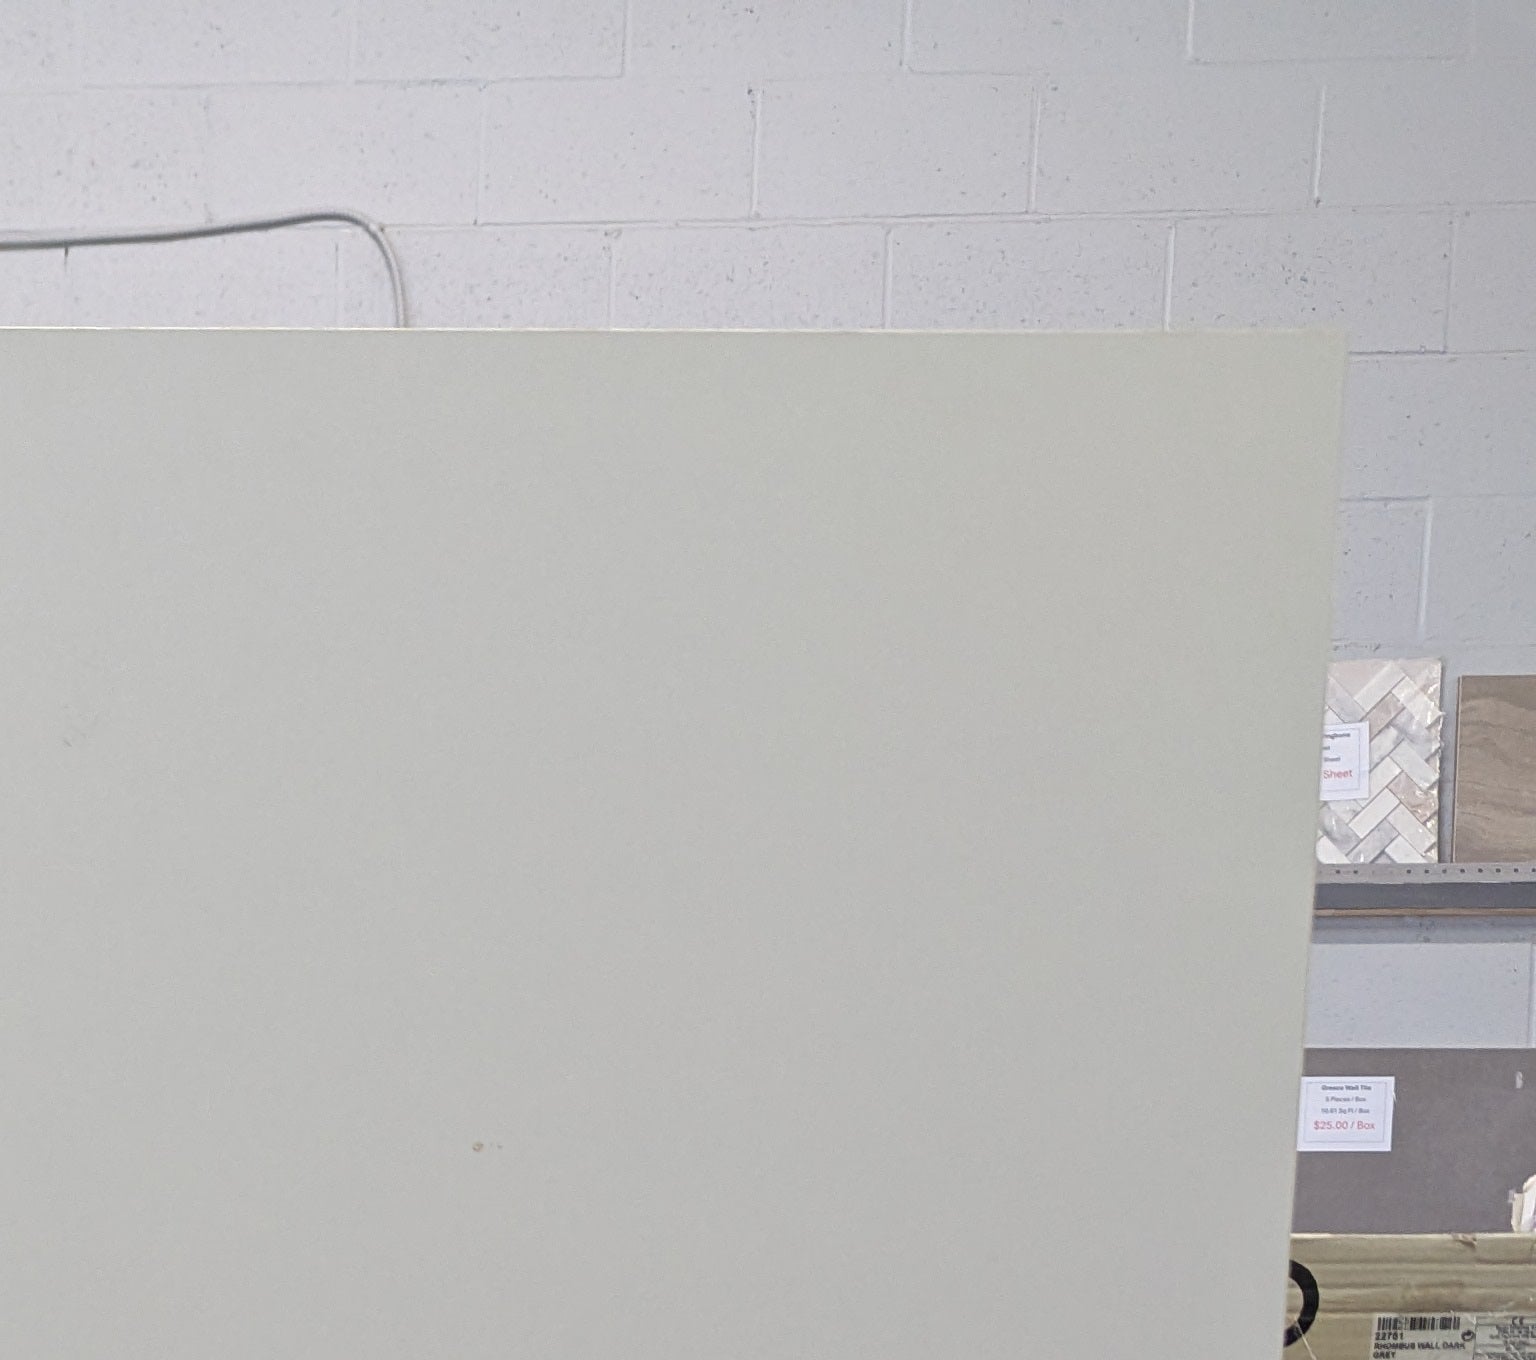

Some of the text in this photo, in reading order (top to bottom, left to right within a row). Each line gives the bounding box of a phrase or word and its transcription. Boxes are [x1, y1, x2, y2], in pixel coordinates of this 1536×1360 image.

[1323, 769, 1353, 780] Sheet
[1313, 1120, 1349, 1131] $25.00
[1356, 1120, 1376, 1131] Box
[1417, 1342, 1441, 1350] WALL
[1372, 1351, 1396, 1360] GREY
